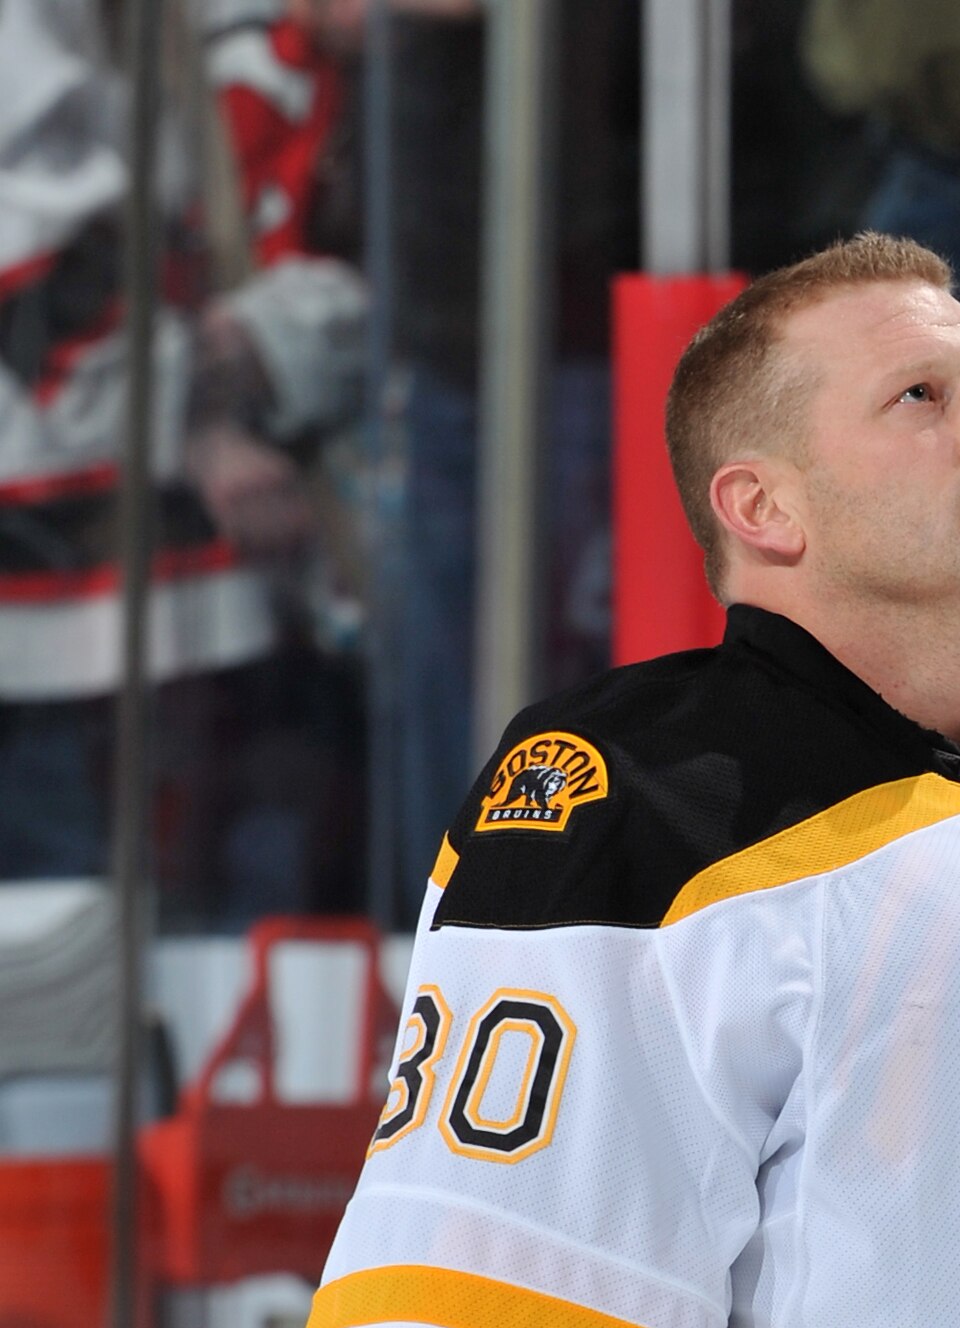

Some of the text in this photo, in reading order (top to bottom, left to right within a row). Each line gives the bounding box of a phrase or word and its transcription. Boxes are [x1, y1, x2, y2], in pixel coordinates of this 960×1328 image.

[489, 739, 599, 800] BOSTON
[491, 809, 553, 820] BRUINS
[366, 984, 578, 1165] 30
